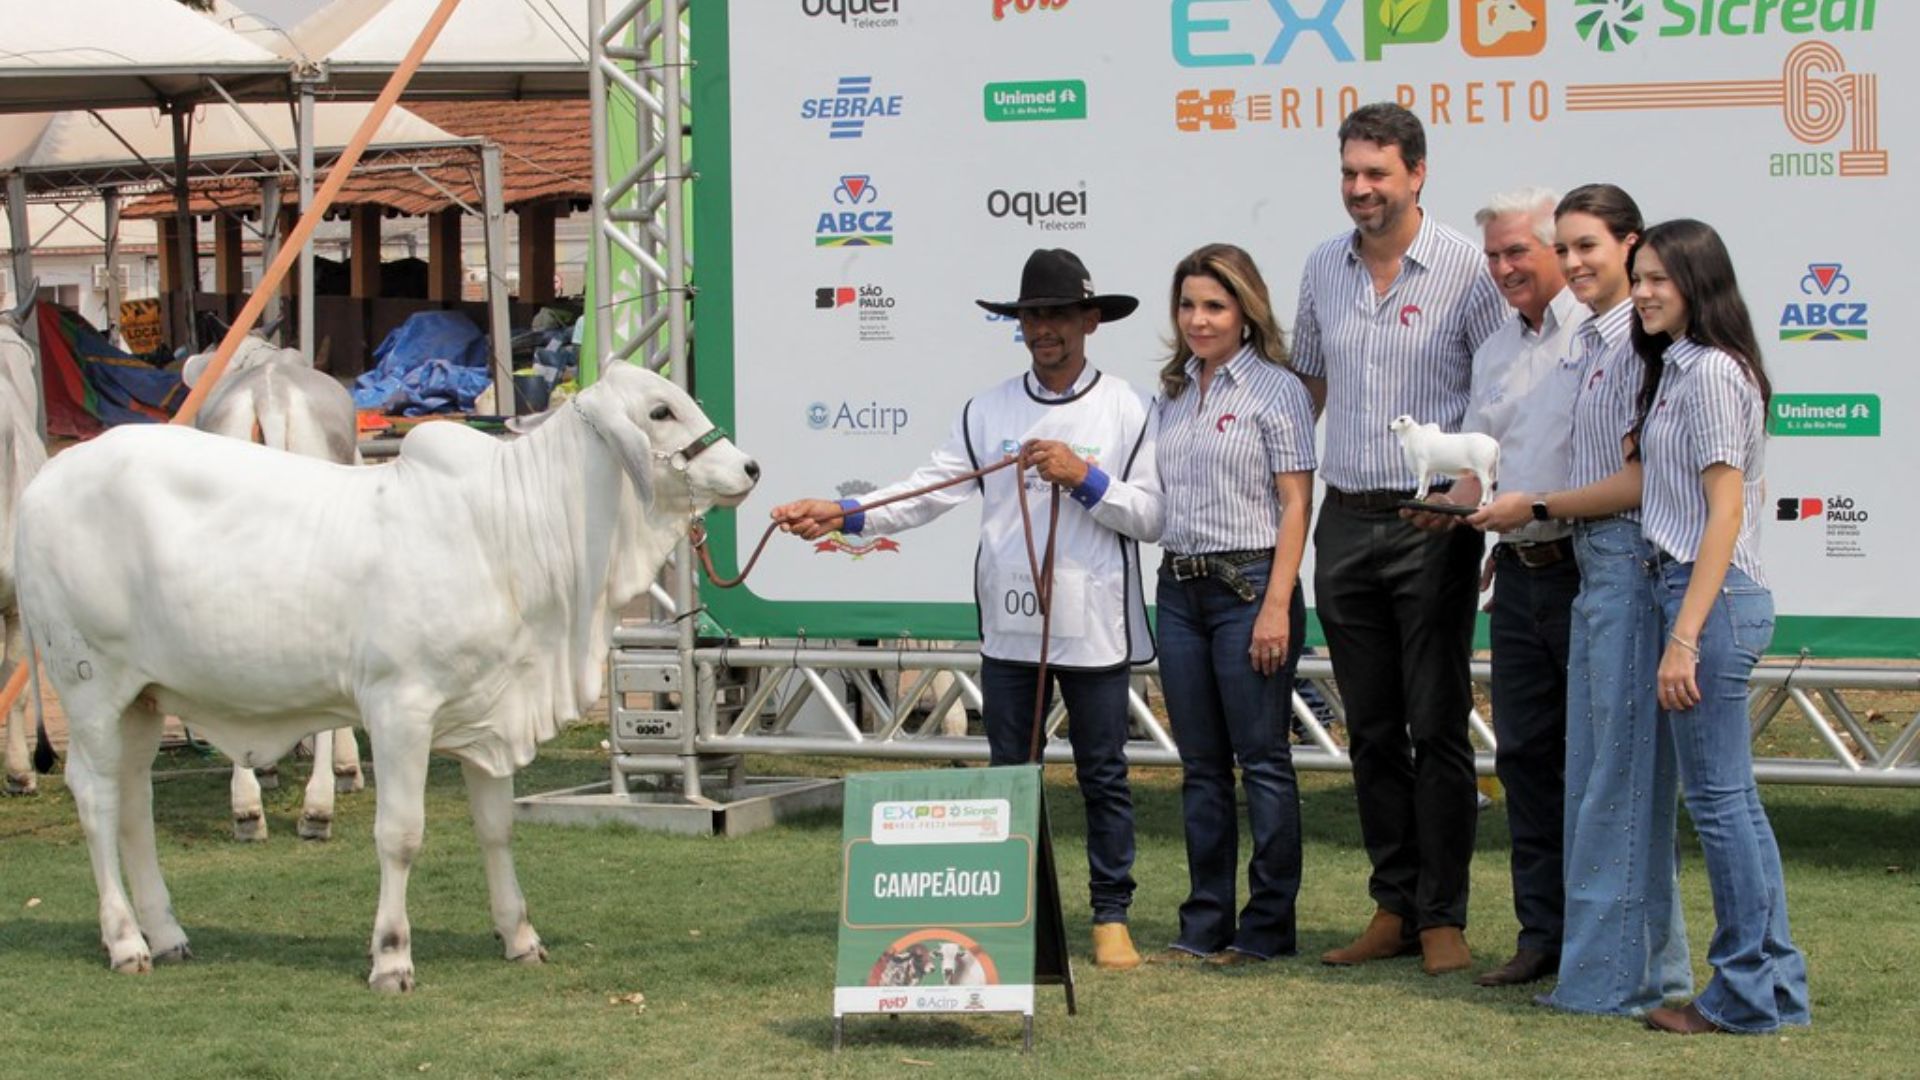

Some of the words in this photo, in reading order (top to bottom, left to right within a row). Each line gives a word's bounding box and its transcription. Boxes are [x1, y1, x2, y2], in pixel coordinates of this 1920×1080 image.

[852, 18, 898, 28] Telecom
[993, 89, 1056, 105] Unimed
[801, 95, 903, 119] SEBRAE
[1770, 152, 1834, 177] anos
[816, 211, 893, 233] ABCZ
[1039, 219, 1087, 231] Telecom
[860, 284, 882, 297] SÃO
[860, 297, 895, 308] PAULO
[1779, 303, 1868, 326] ABCZ
[832, 401, 908, 435] Acirp
[1777, 403, 1847, 418] Unimed
[1827, 495, 1854, 509] SÃO
[1827, 510, 1868, 522] PAULO
[874, 867, 1001, 898] CAMPEÃO(A)
